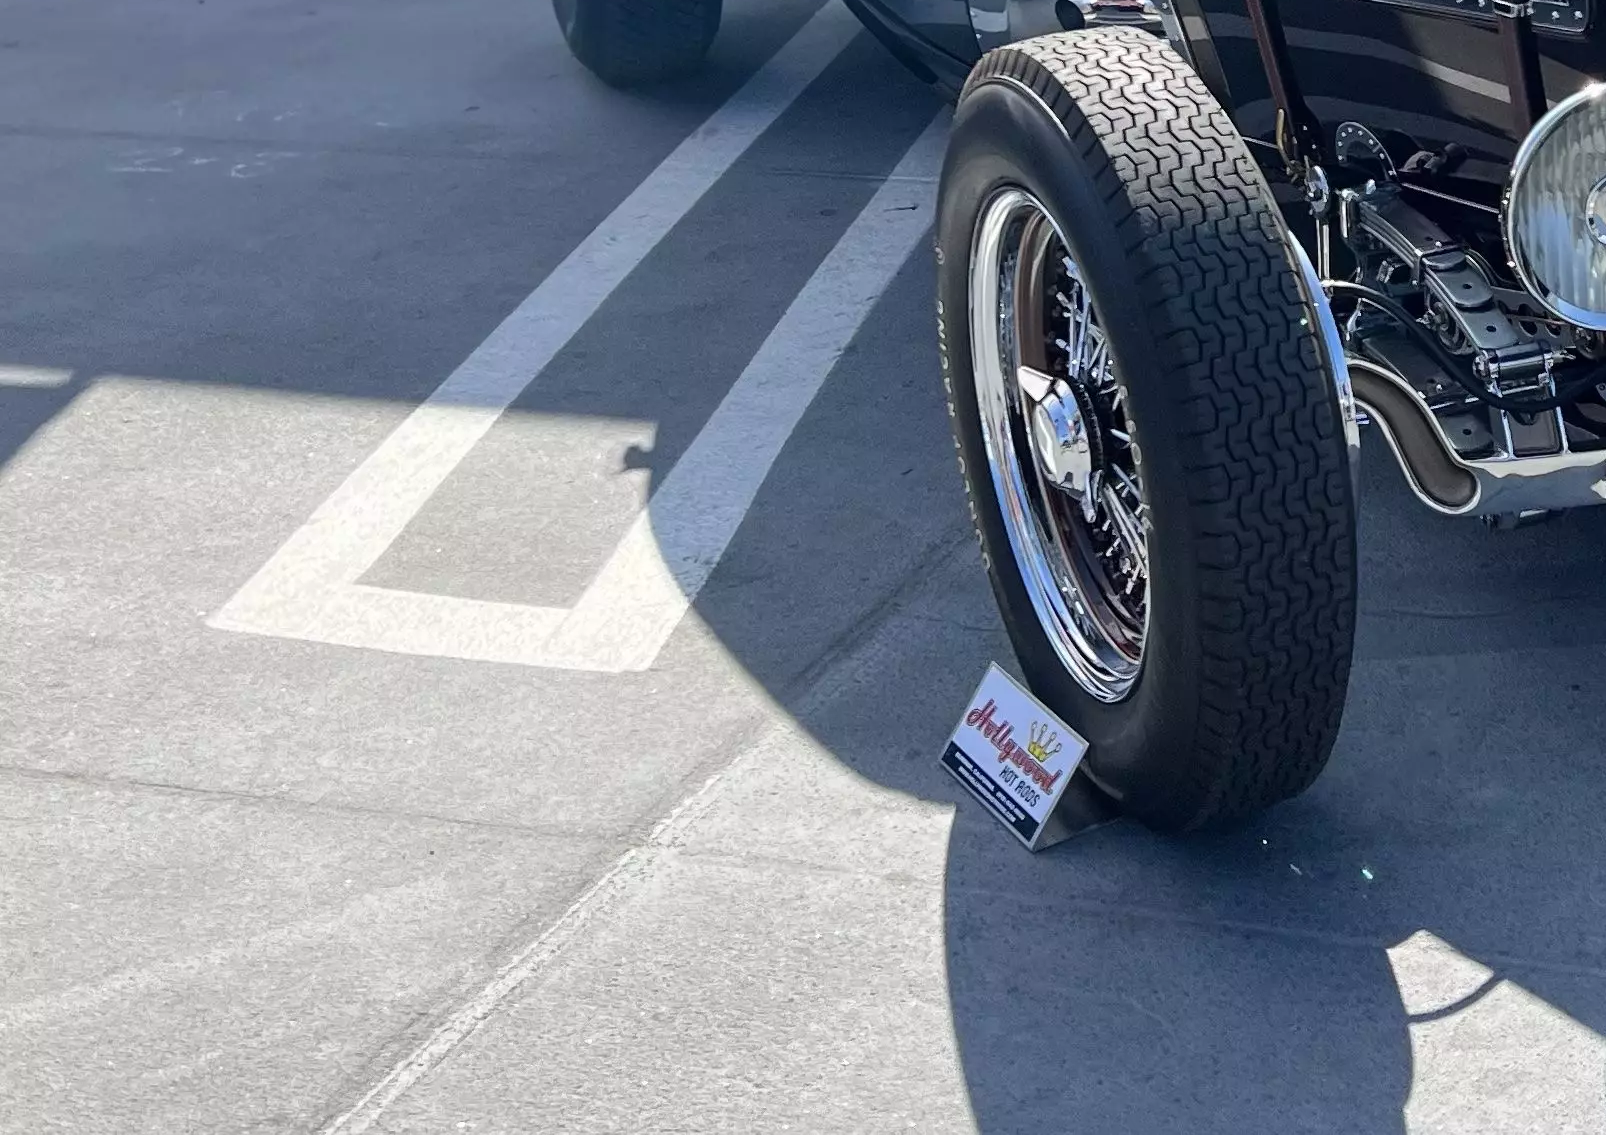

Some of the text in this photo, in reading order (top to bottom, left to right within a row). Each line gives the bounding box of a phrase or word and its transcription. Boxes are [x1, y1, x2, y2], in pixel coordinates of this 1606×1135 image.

[966, 698, 1064, 795] Hollywood
[999, 765, 1040, 808] HOT RODS
